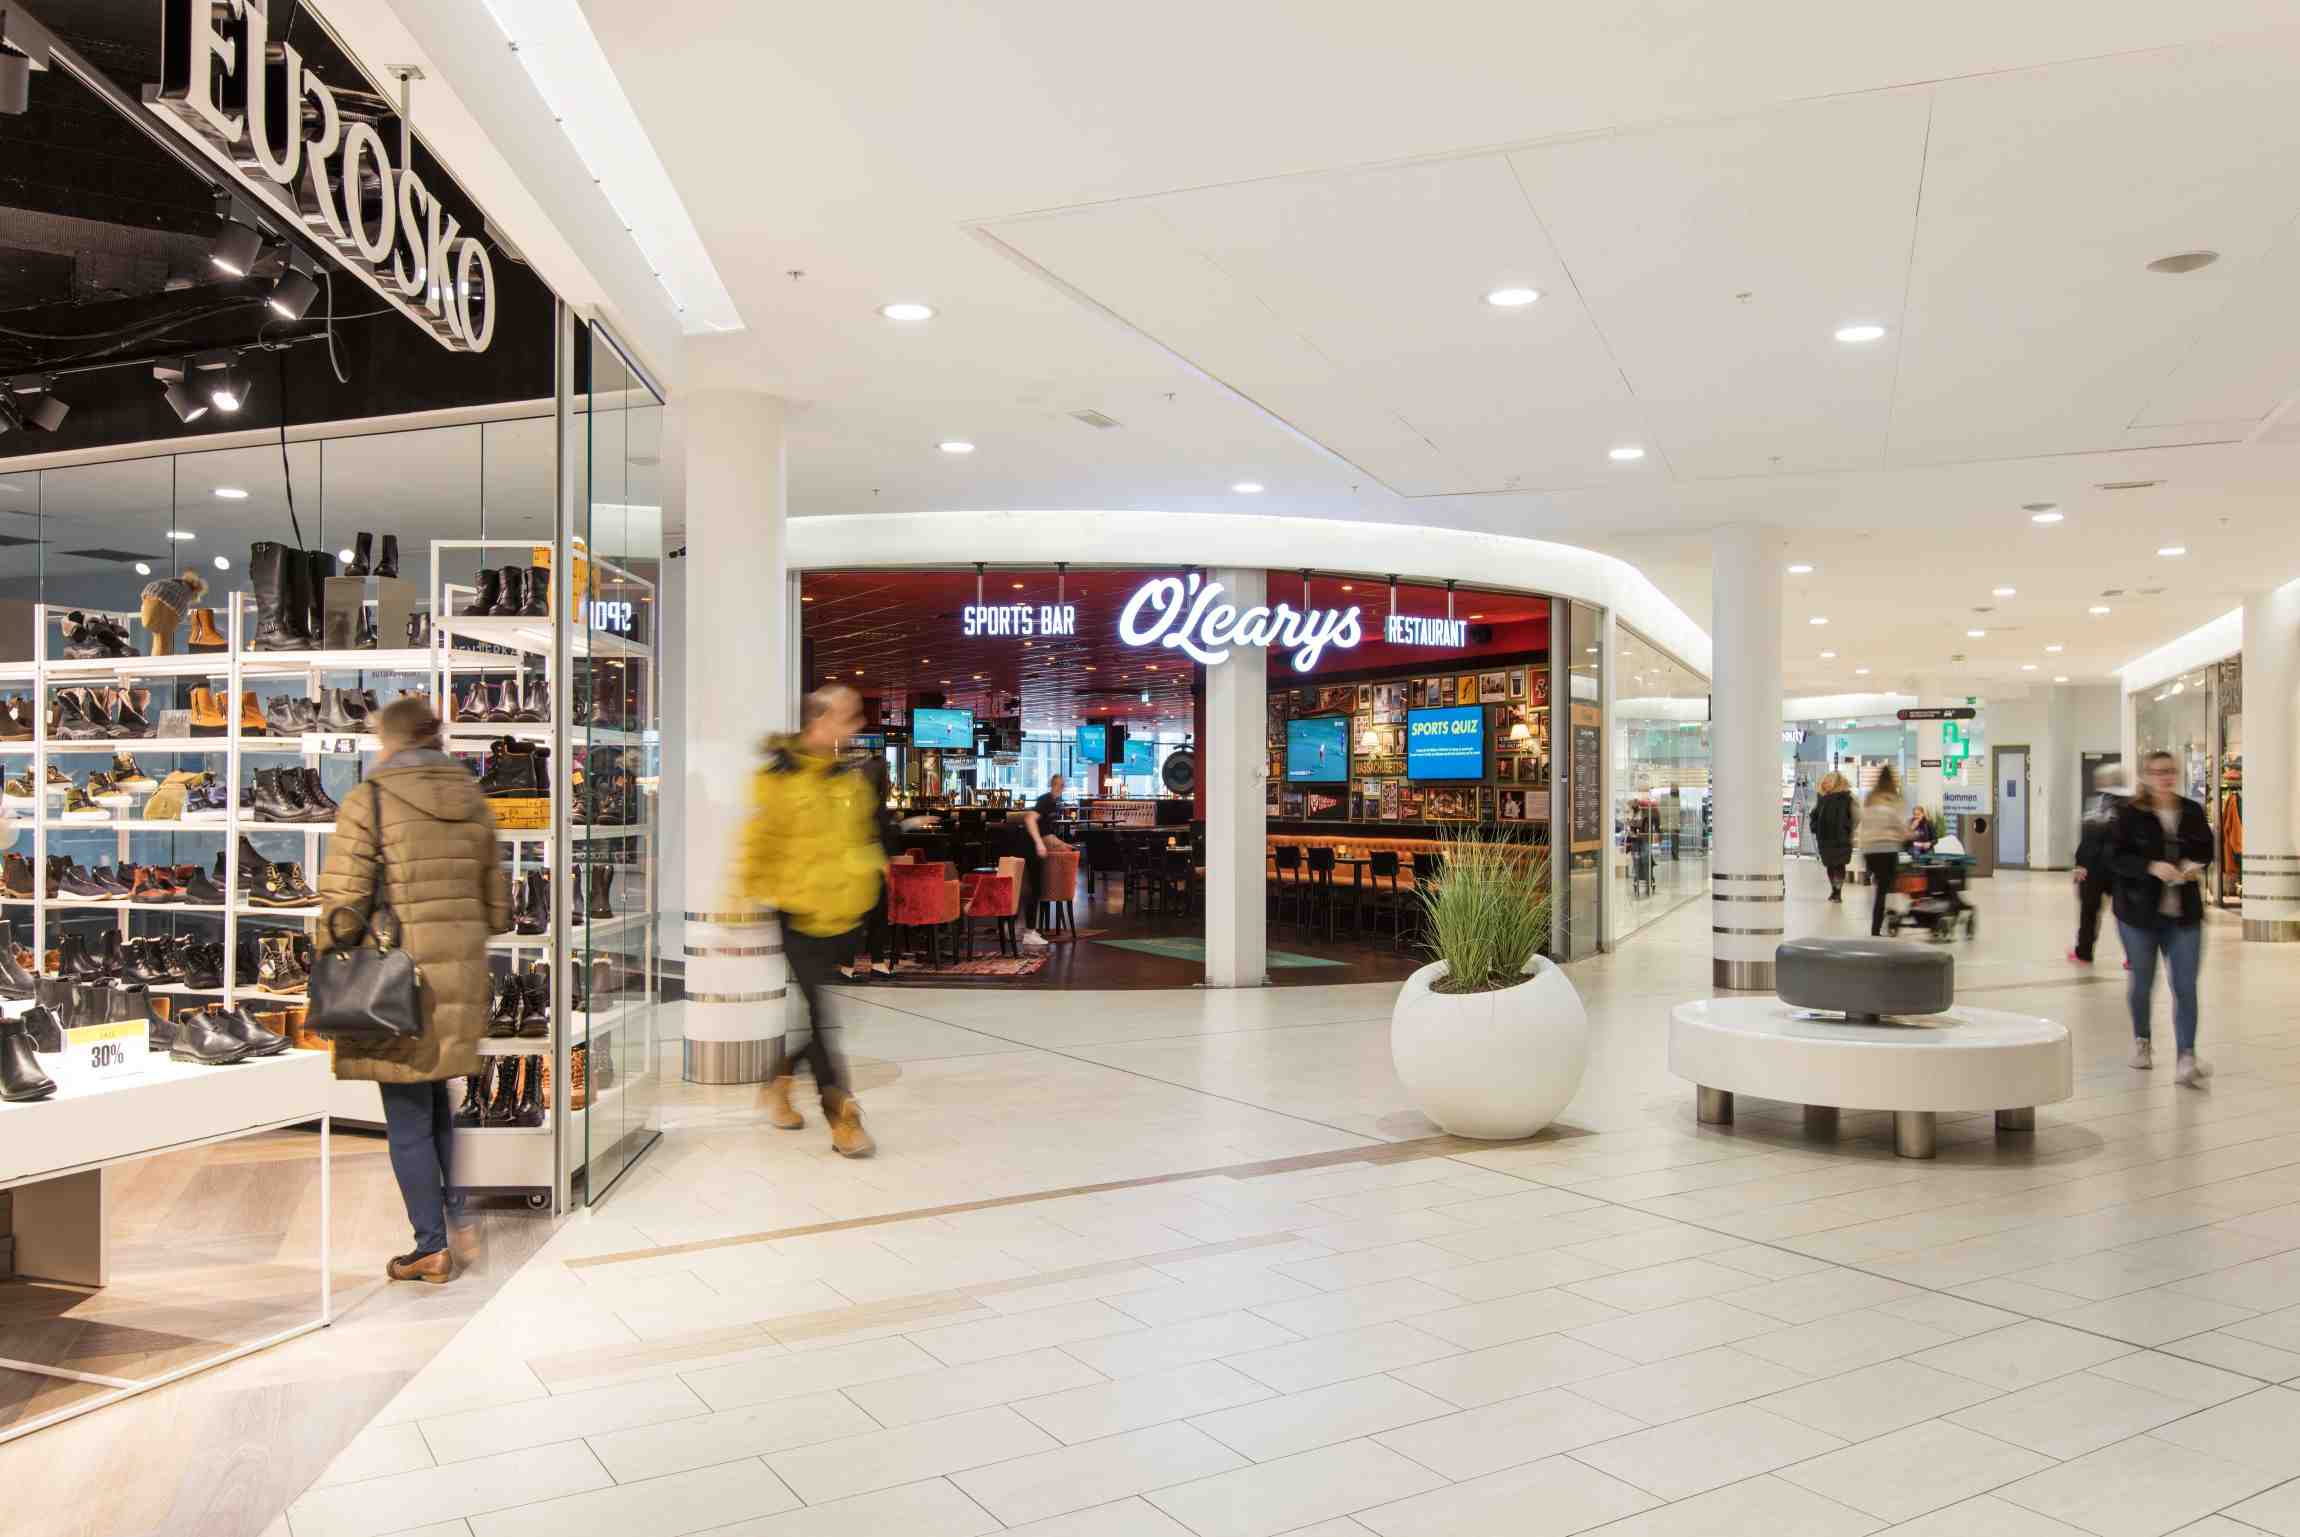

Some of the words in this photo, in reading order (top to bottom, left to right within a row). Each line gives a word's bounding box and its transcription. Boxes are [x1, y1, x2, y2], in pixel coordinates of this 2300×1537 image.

[160, 0, 495, 352] EUROSKO
[964, 606, 1033, 635] SPORTS
[1041, 606, 1075, 635] BAR
[1119, 573, 1362, 672] O'Learys
[1385, 616, 1467, 648] RESTAURANT
[1411, 721, 1448, 736] SPORTS
[1451, 719, 1478, 735] QUIZ
[91, 1043, 124, 1068] 30%
